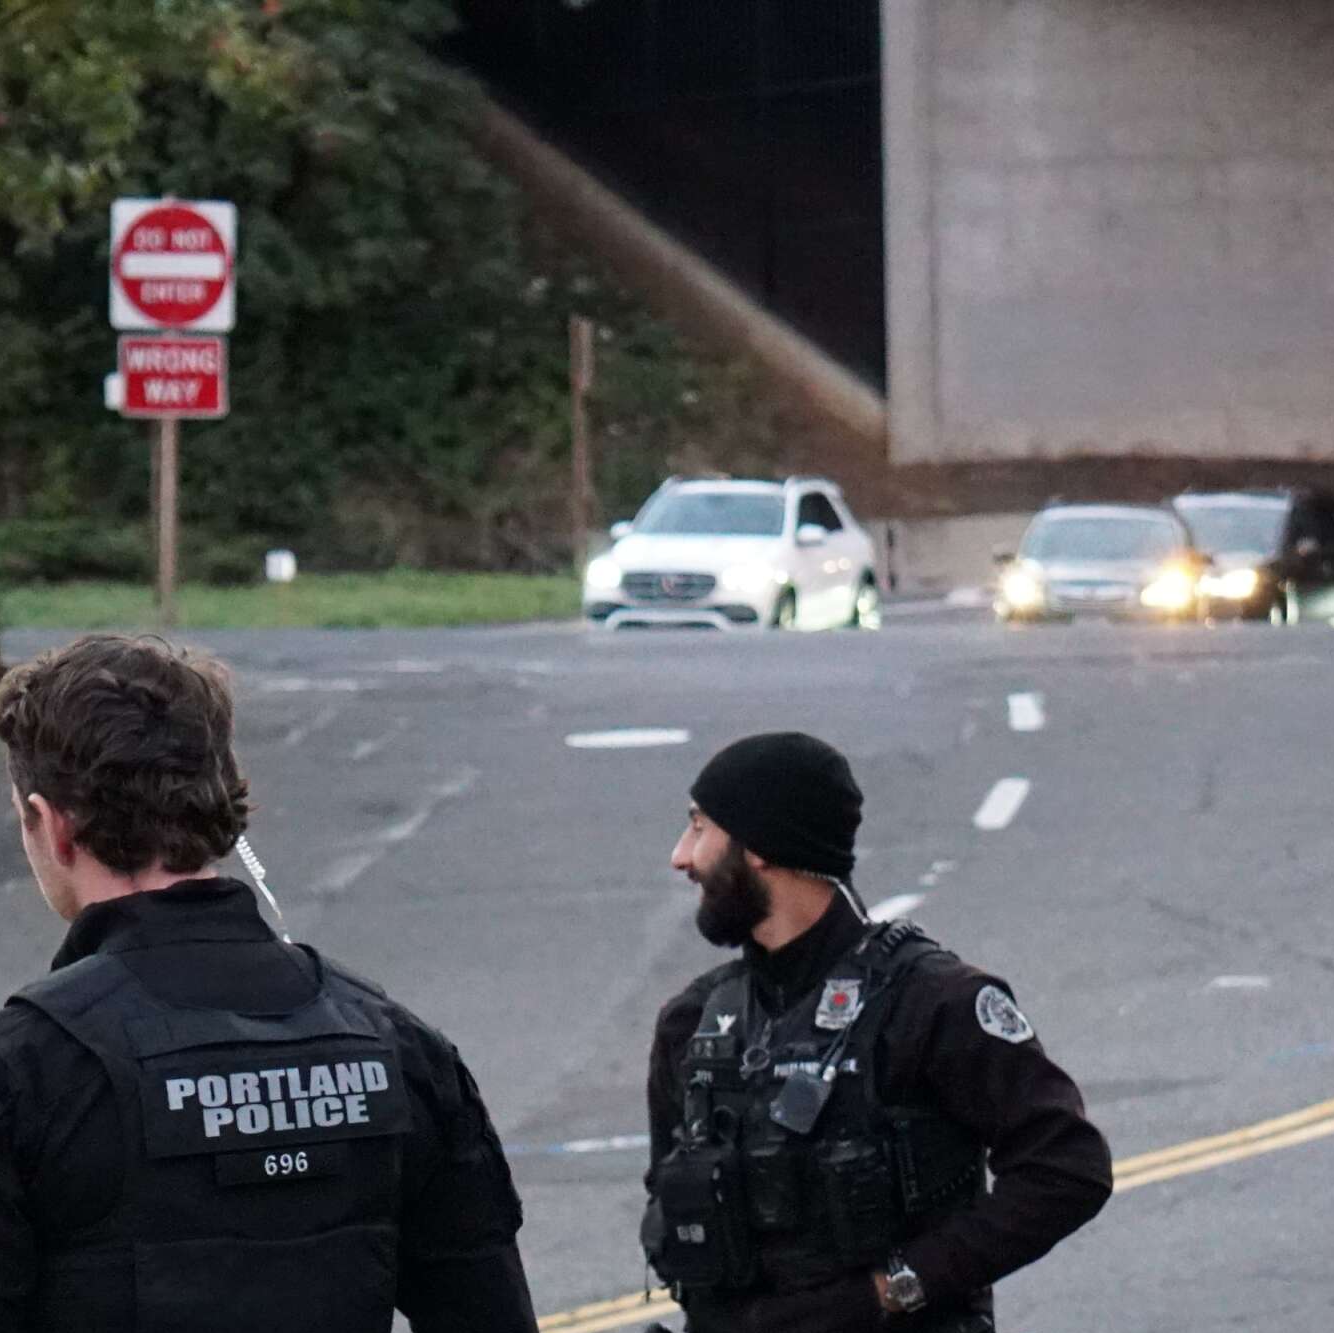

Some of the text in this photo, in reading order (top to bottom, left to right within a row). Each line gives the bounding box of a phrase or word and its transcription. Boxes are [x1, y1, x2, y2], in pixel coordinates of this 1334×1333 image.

[132, 227, 212, 250] DO NOT
[140, 283, 206, 303] ENTER
[126, 347, 218, 372] WRONG
[143, 379, 202, 405] WAY
[165, 1061, 389, 1111] PORTLAND
[202, 1095, 370, 1138] POLICE
[264, 1151, 309, 1176] 696
